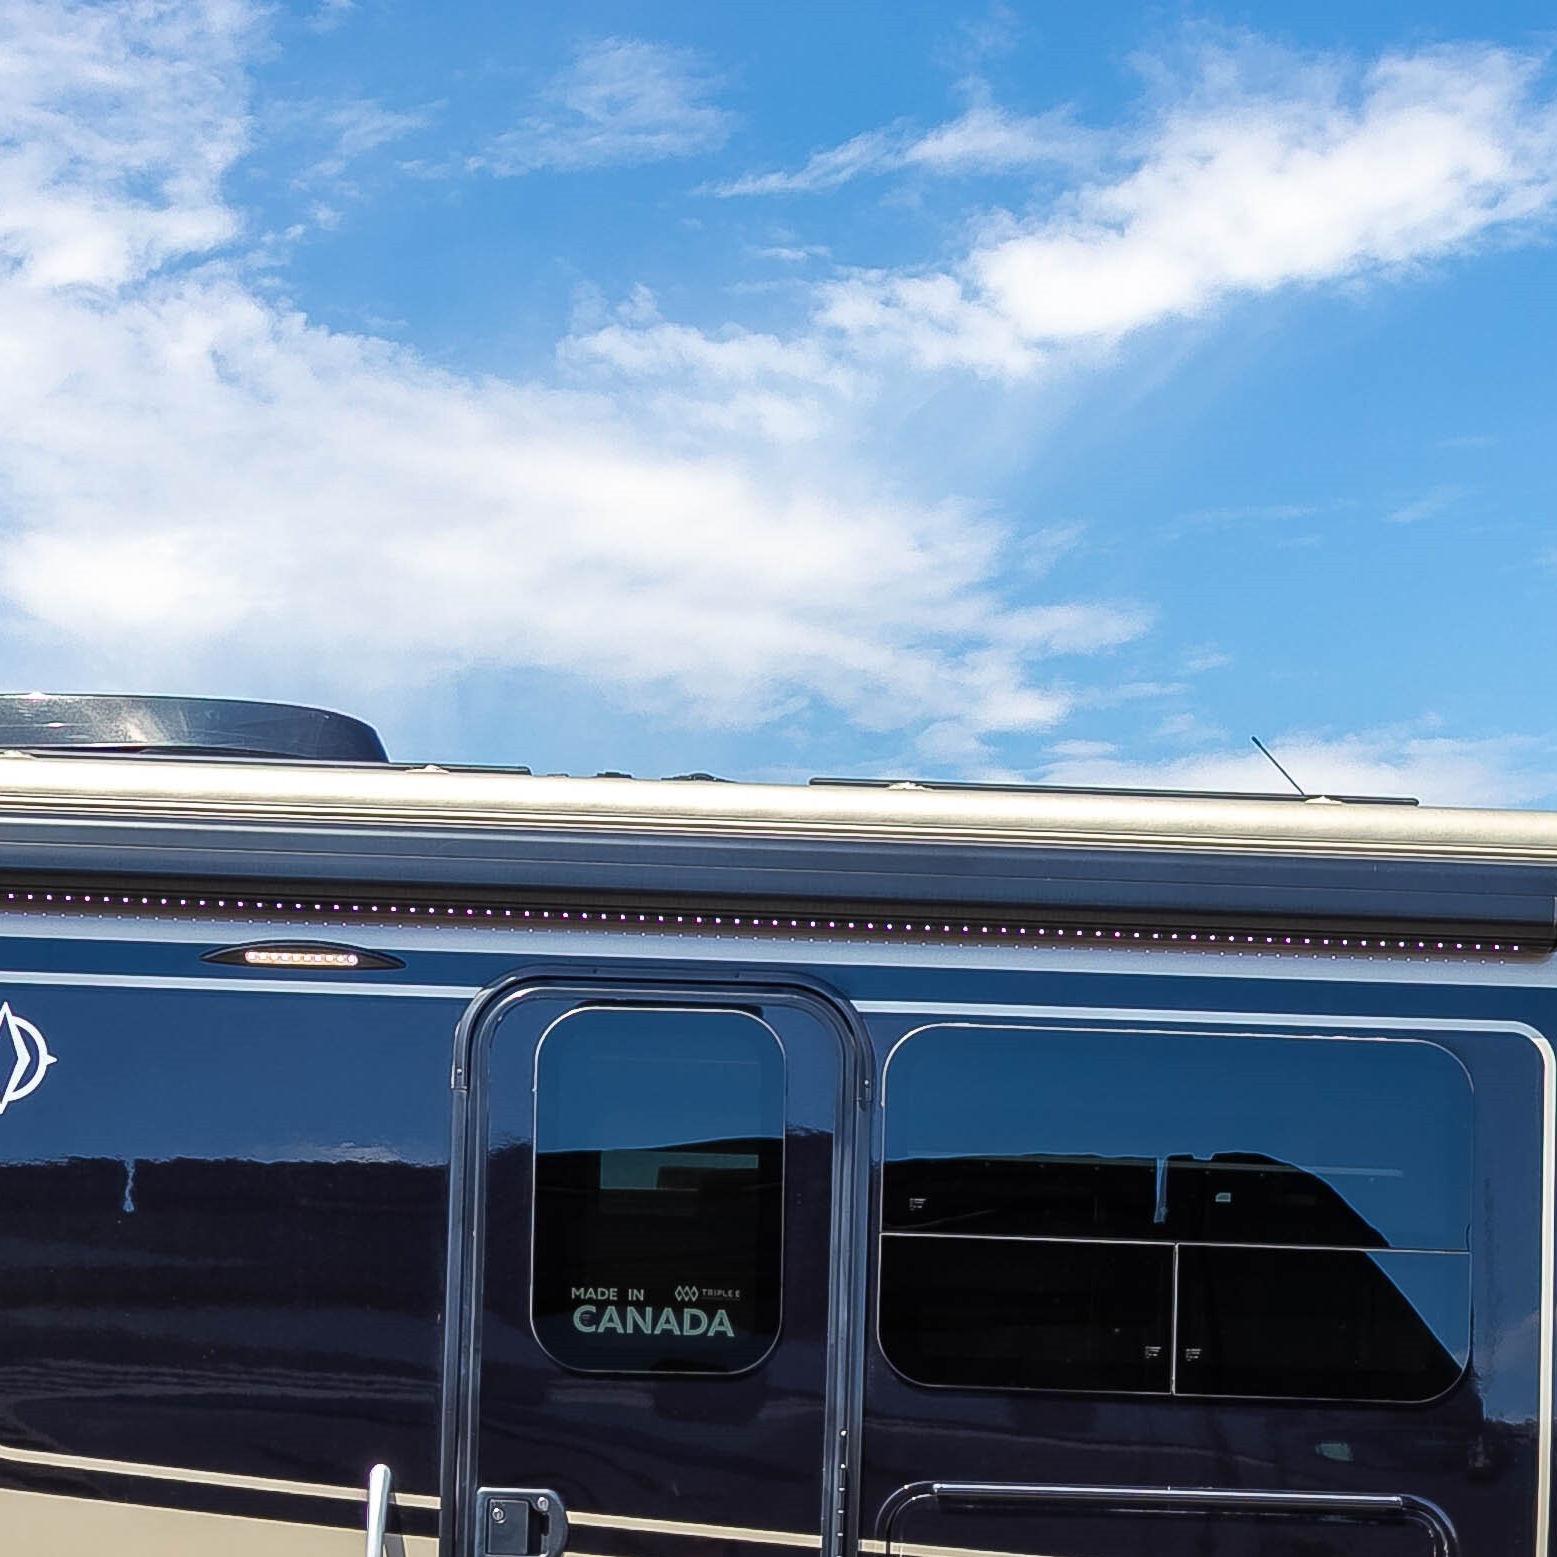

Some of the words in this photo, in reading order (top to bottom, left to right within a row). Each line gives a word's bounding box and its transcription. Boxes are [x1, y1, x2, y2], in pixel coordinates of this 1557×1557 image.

[571, 1287, 618, 1300] MADE
[628, 1288, 644, 1301] IN
[573, 1304, 735, 1337] CANADA
